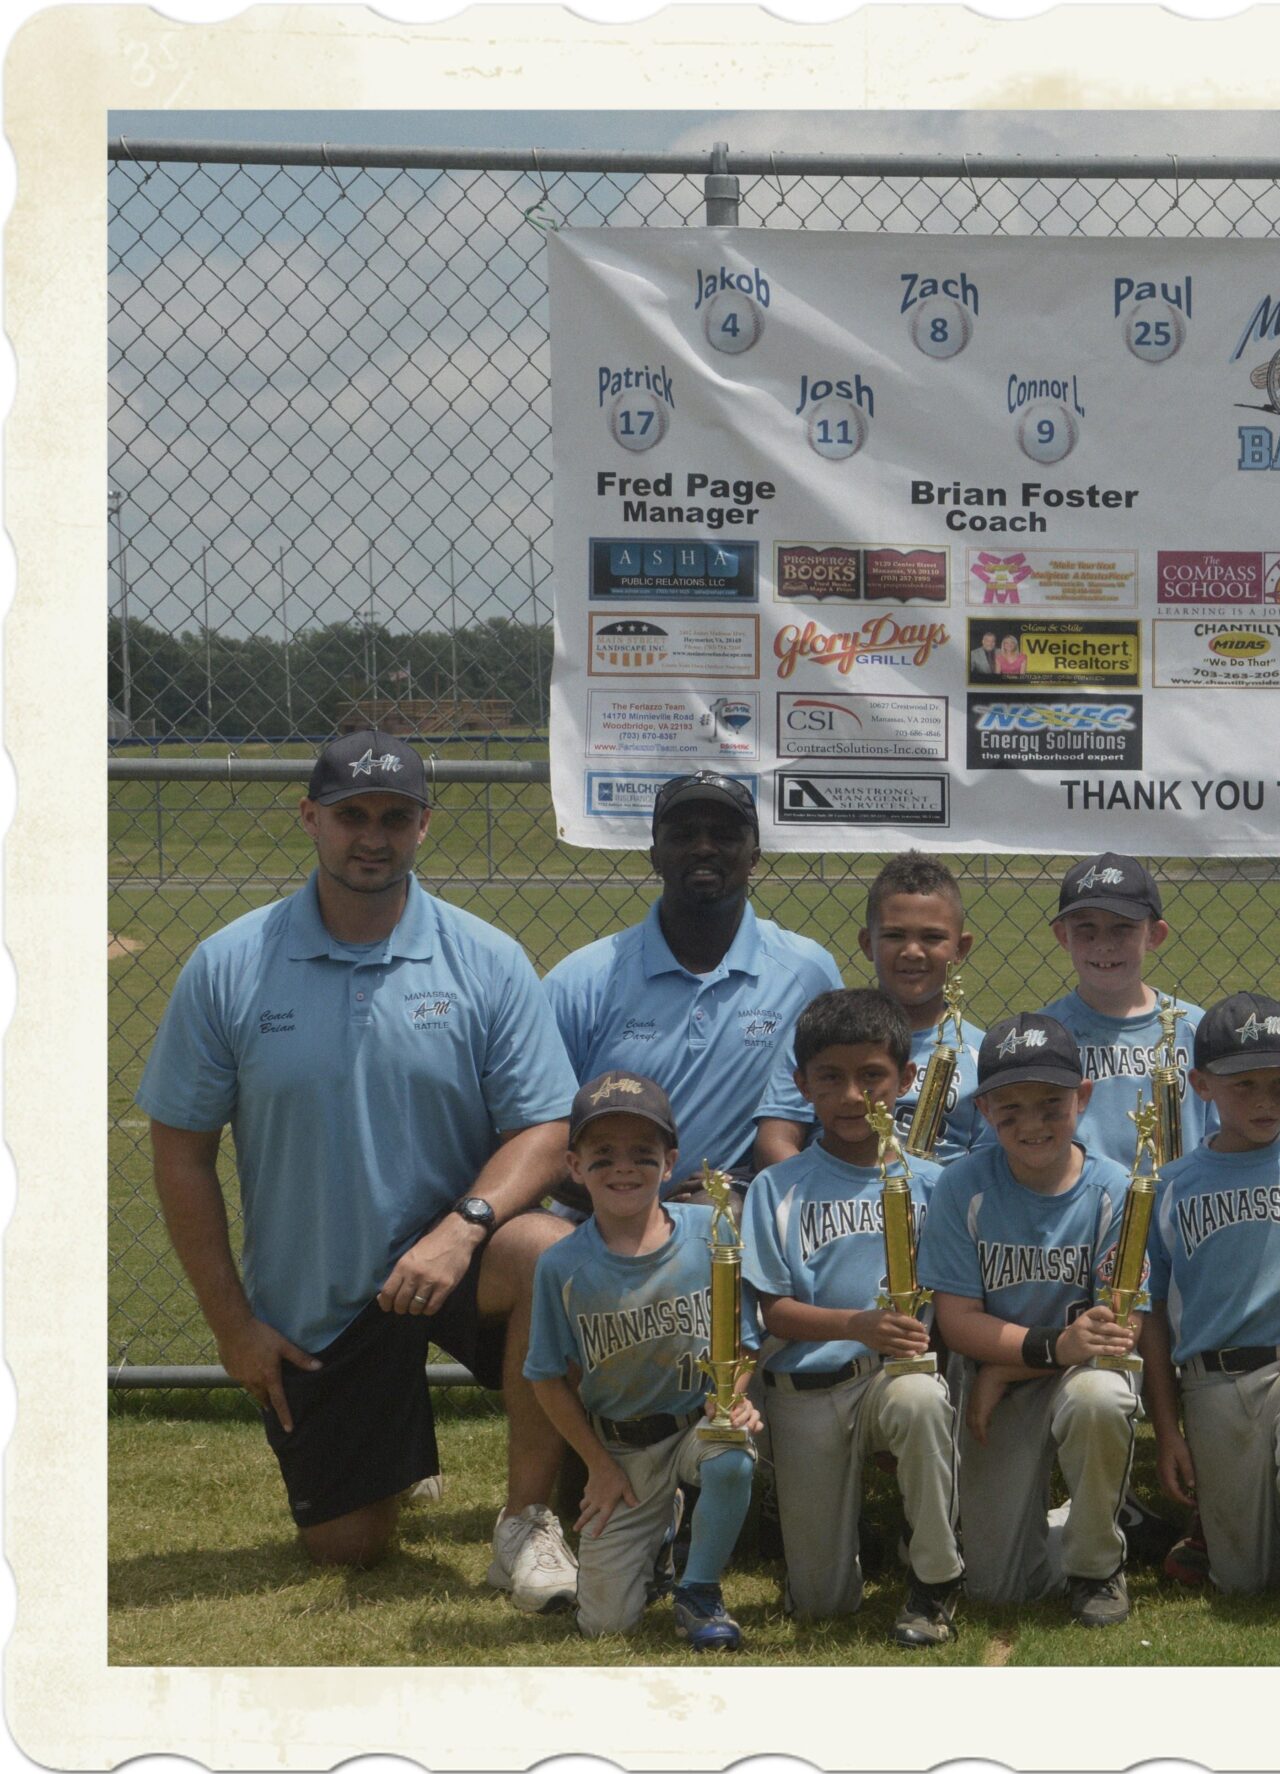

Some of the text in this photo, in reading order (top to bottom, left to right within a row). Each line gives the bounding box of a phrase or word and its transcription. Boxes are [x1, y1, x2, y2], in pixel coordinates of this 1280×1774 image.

[695, 266, 770, 309] Jakob
[900, 273, 979, 316] Zach
[1114, 276, 1192, 319] Paul
[721, 313, 740, 337] 4
[930, 318, 949, 343] 8
[1134, 322, 1171, 346] 25
[599, 365, 675, 409] Patrick
[1007, 373, 1068, 414] Connor
[796, 375, 874, 417] Josh
[619, 411, 655, 436] 17
[816, 420, 853, 444] 11
[1036, 420, 1055, 444] 9
[597, 472, 776, 500] Fred Page
[911, 481, 1139, 508] Brian Foster
[622, 502, 759, 529] Manager
[946, 510, 1047, 533] Coach
[783, 555, 856, 565] PROSPERO'S
[1203, 555, 1220, 564] The
[784, 565, 856, 581] BOOKS
[1163, 565, 1257, 581] COMPASS
[621, 577, 653, 586] PUBLIC
[708, 579, 725, 587] LLC
[1164, 581, 1257, 598] SCHOOL
[1157, 607, 1225, 615] LEARNING
[774, 613, 951, 678] Glory Days
[1025, 639, 1129, 656] Weichert
[1213, 640, 1267, 650] MIDAS
[856, 655, 911, 666] GRILL
[1054, 656, 1130, 670] Realtors
[1230, 659, 1244, 667] Do
[612, 702, 627, 710] The
[673, 713, 694, 721] Road
[787, 709, 834, 731] CSI
[907, 716, 918, 724] VA
[980, 703, 1134, 731] NOVEC
[619, 732, 639, 741] (703)
[981, 731, 1126, 752] Energy Solutions
[787, 741, 938, 756] ContractSolutions-Inc.com
[1004, 752, 1084, 762] neighborhood
[1088, 753, 1124, 762] expert
[824, 787, 913, 795] ARMSTRONG
[831, 795, 930, 803] MANAGEMENT
[1060, 780, 1182, 810] THANK
[1192, 780, 1265, 810] YOU
[404, 991, 458, 1001] MANASSAS
[260, 1009, 295, 1022] Coach
[738, 1009, 783, 1020] MANASSAS
[259, 1023, 295, 1034] Brian
[414, 1021, 449, 1031] BATTLE
[626, 1018, 656, 1028] Coach
[622, 1030, 657, 1041] Daryl
[744, 1040, 774, 1048] BATTLE
[977, 1240, 1096, 1292] MANASSA
[577, 1286, 712, 1373] MANASSA
